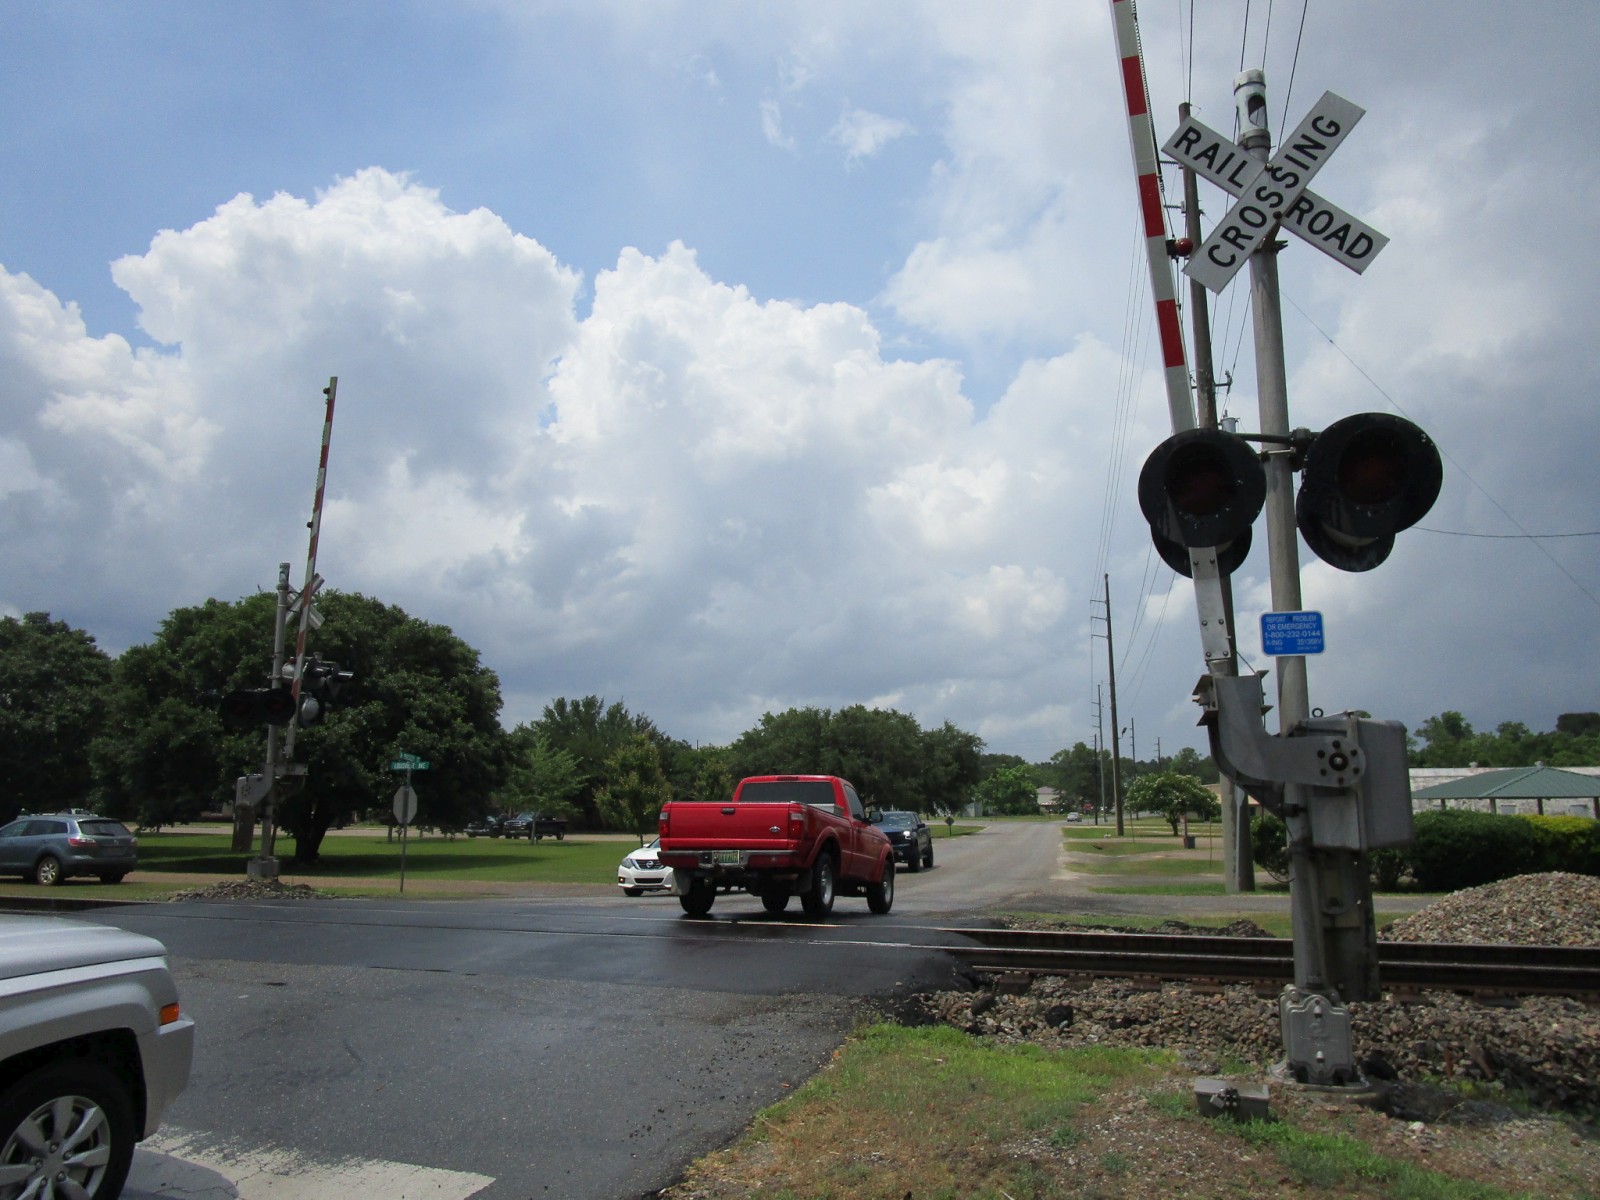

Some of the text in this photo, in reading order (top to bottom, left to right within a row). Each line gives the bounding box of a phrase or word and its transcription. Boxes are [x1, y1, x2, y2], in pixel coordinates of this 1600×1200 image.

[1172, 125, 1373, 260] RAIL ROAD
[1207, 115, 1341, 268] CROSSING
